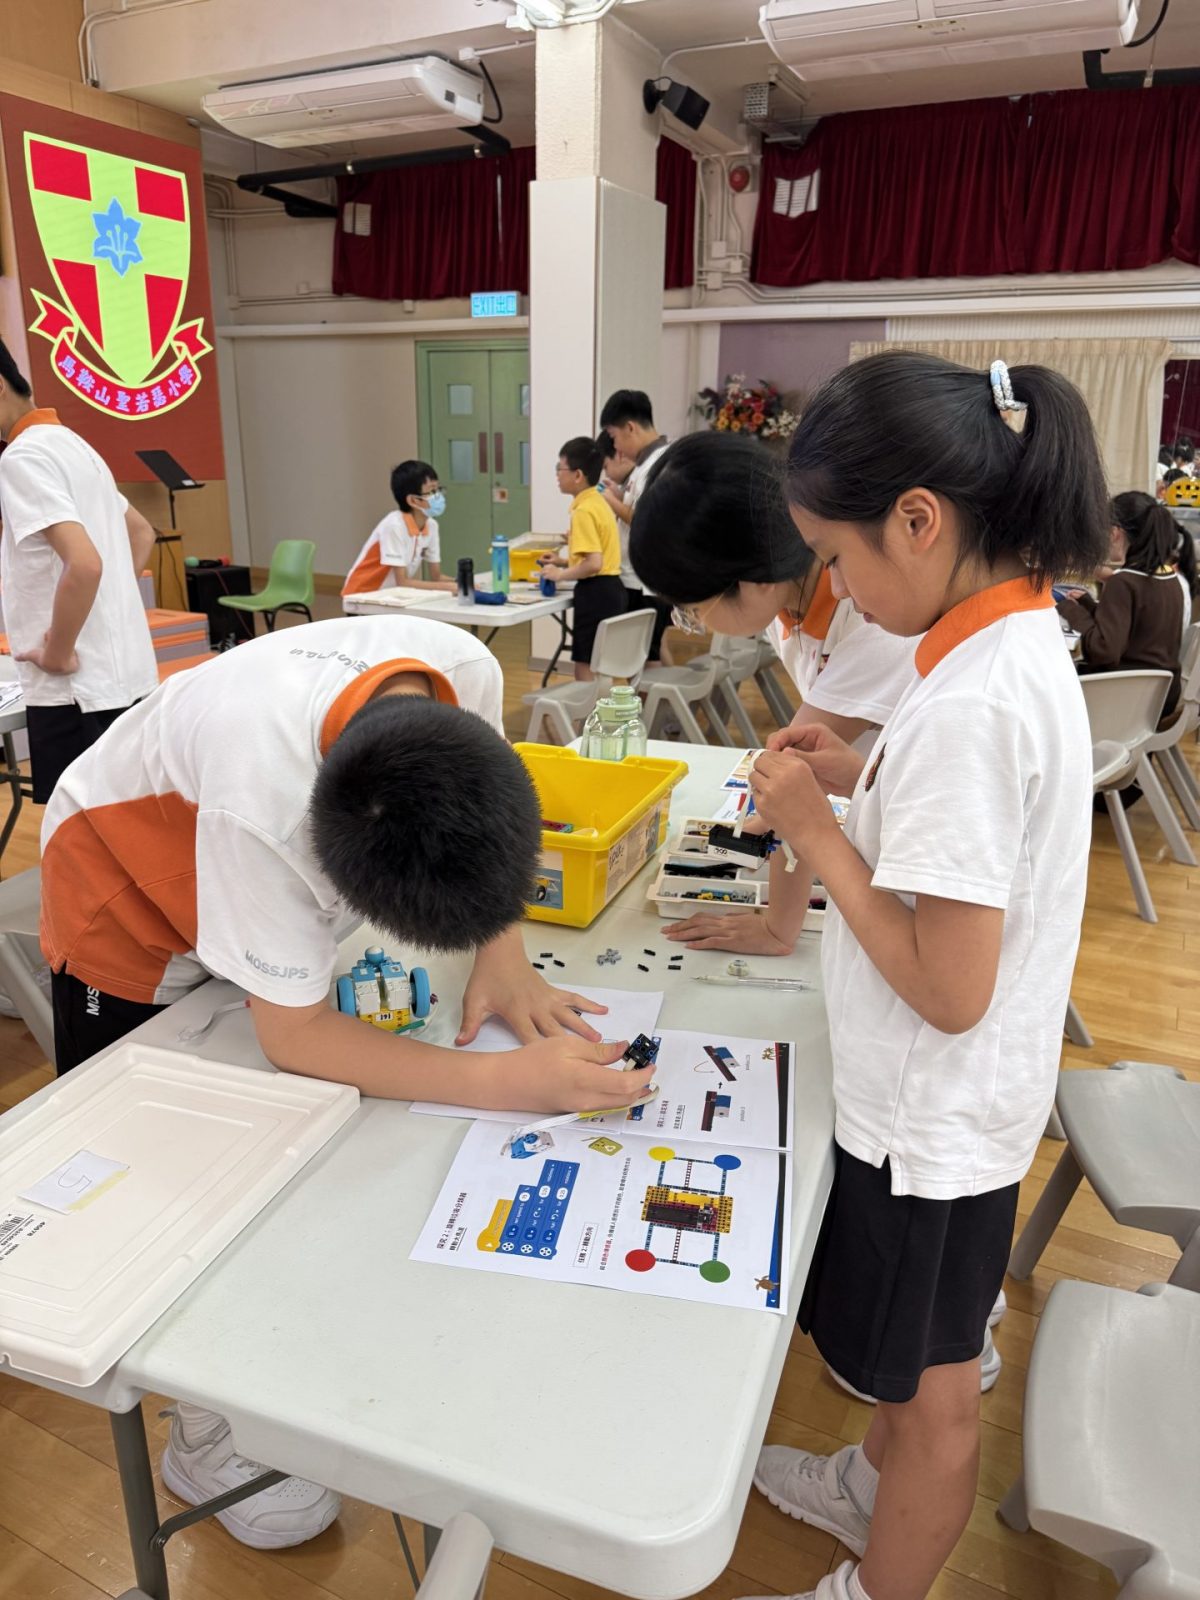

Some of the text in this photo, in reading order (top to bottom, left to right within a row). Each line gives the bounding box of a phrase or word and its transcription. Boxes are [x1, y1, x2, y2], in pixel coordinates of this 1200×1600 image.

[473, 295, 516, 316] EXIT 出口
[245, 949, 309, 979] MOSSJPS
